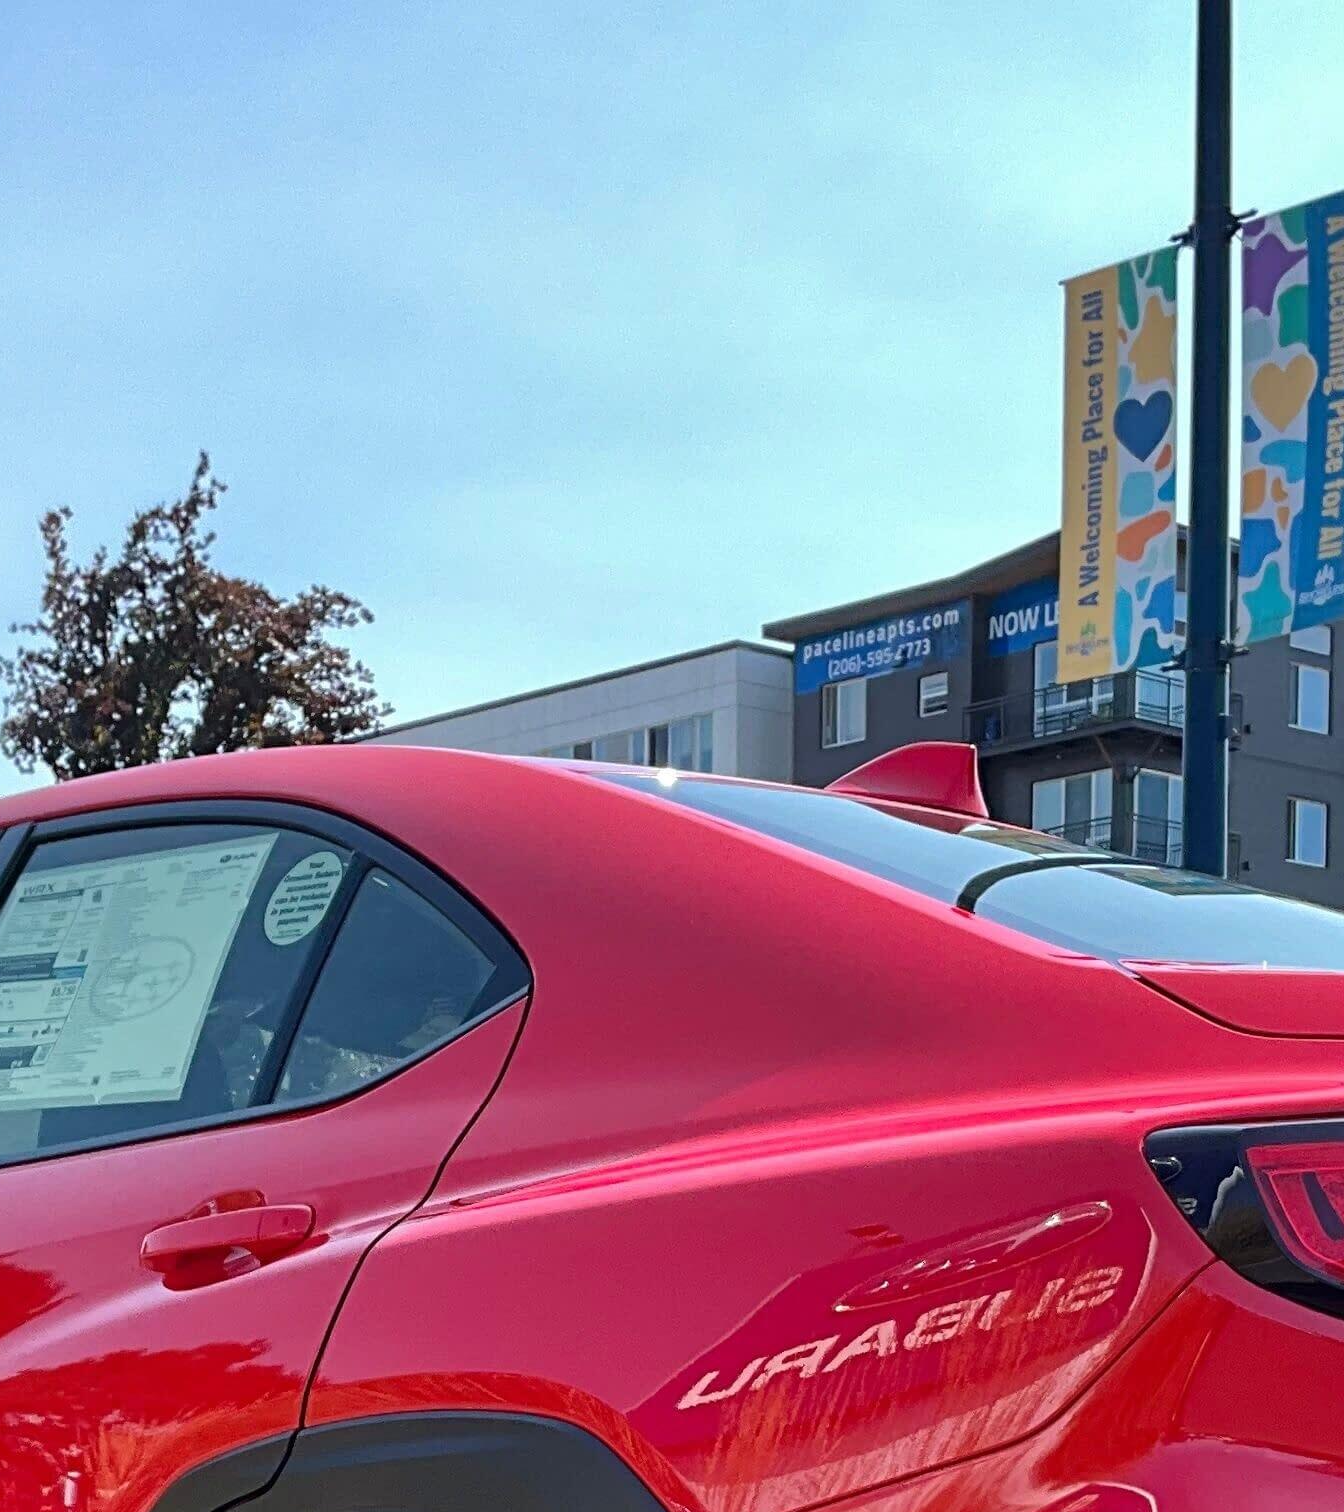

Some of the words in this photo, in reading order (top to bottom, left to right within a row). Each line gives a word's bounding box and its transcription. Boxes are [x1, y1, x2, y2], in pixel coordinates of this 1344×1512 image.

[1081, 290, 1103, 322] All
[1081, 331, 1104, 367] for
[1081, 371, 1104, 443] Place
[1079, 445, 1108, 588] Welcoming
[1318, 526, 1344, 560] All
[1077, 591, 1098, 607] A
[803, 608, 960, 664] pacelineapts.com
[988, 605, 1040, 640] NOW
